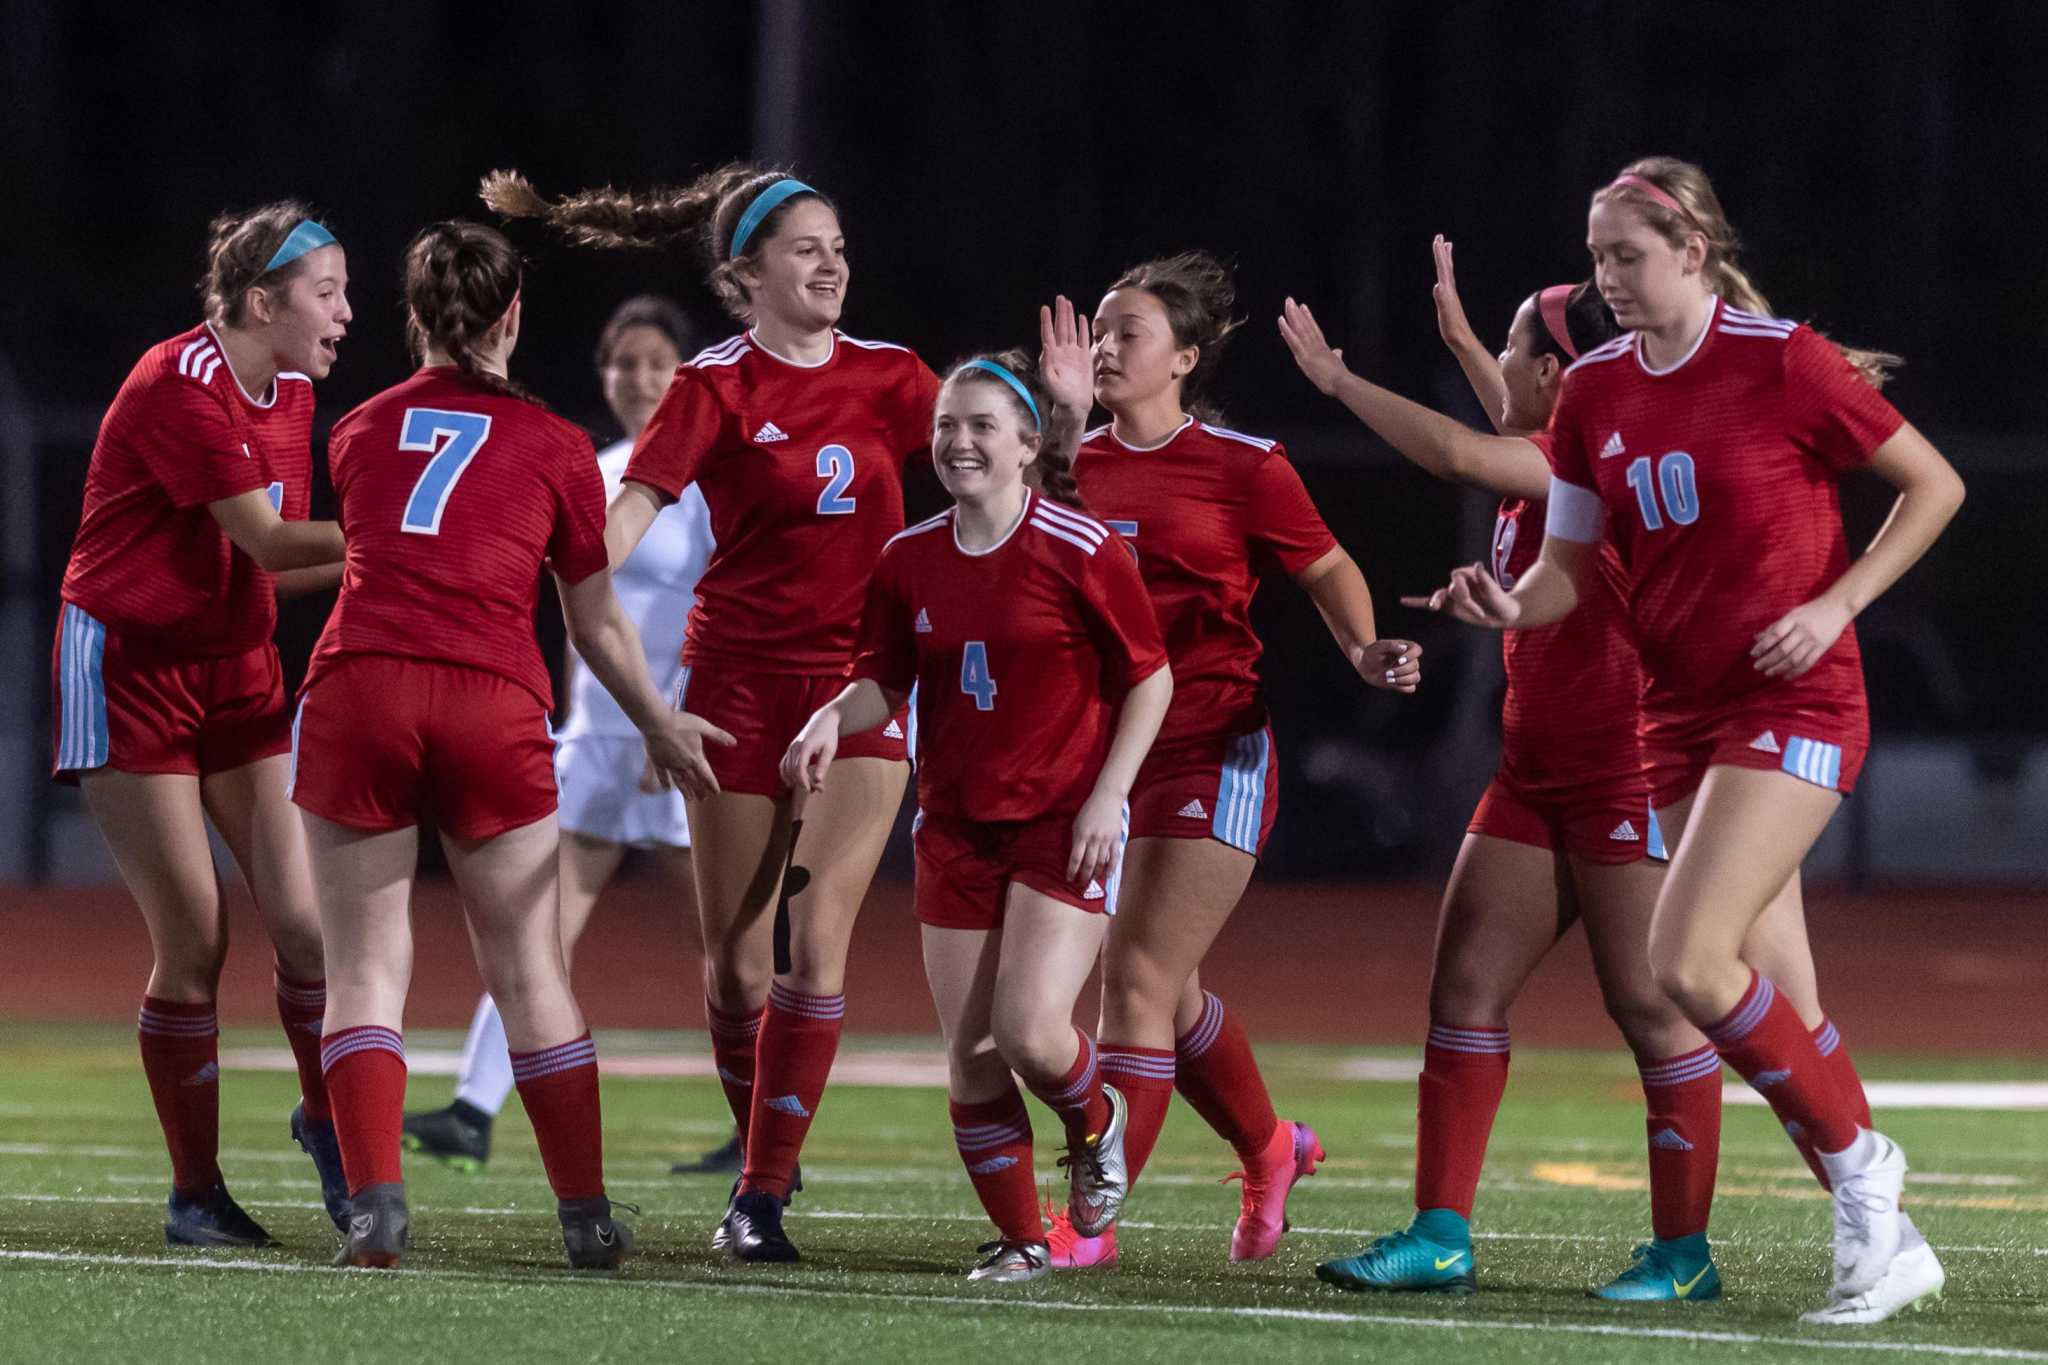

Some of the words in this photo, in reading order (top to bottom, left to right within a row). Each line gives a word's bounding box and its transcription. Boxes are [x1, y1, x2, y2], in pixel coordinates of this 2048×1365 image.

[398, 407, 493, 536] 7
[753, 433, 790, 443] adidas
[816, 444, 856, 515] 2
[1626, 450, 1700, 531] 10
[961, 641, 998, 711] 4
